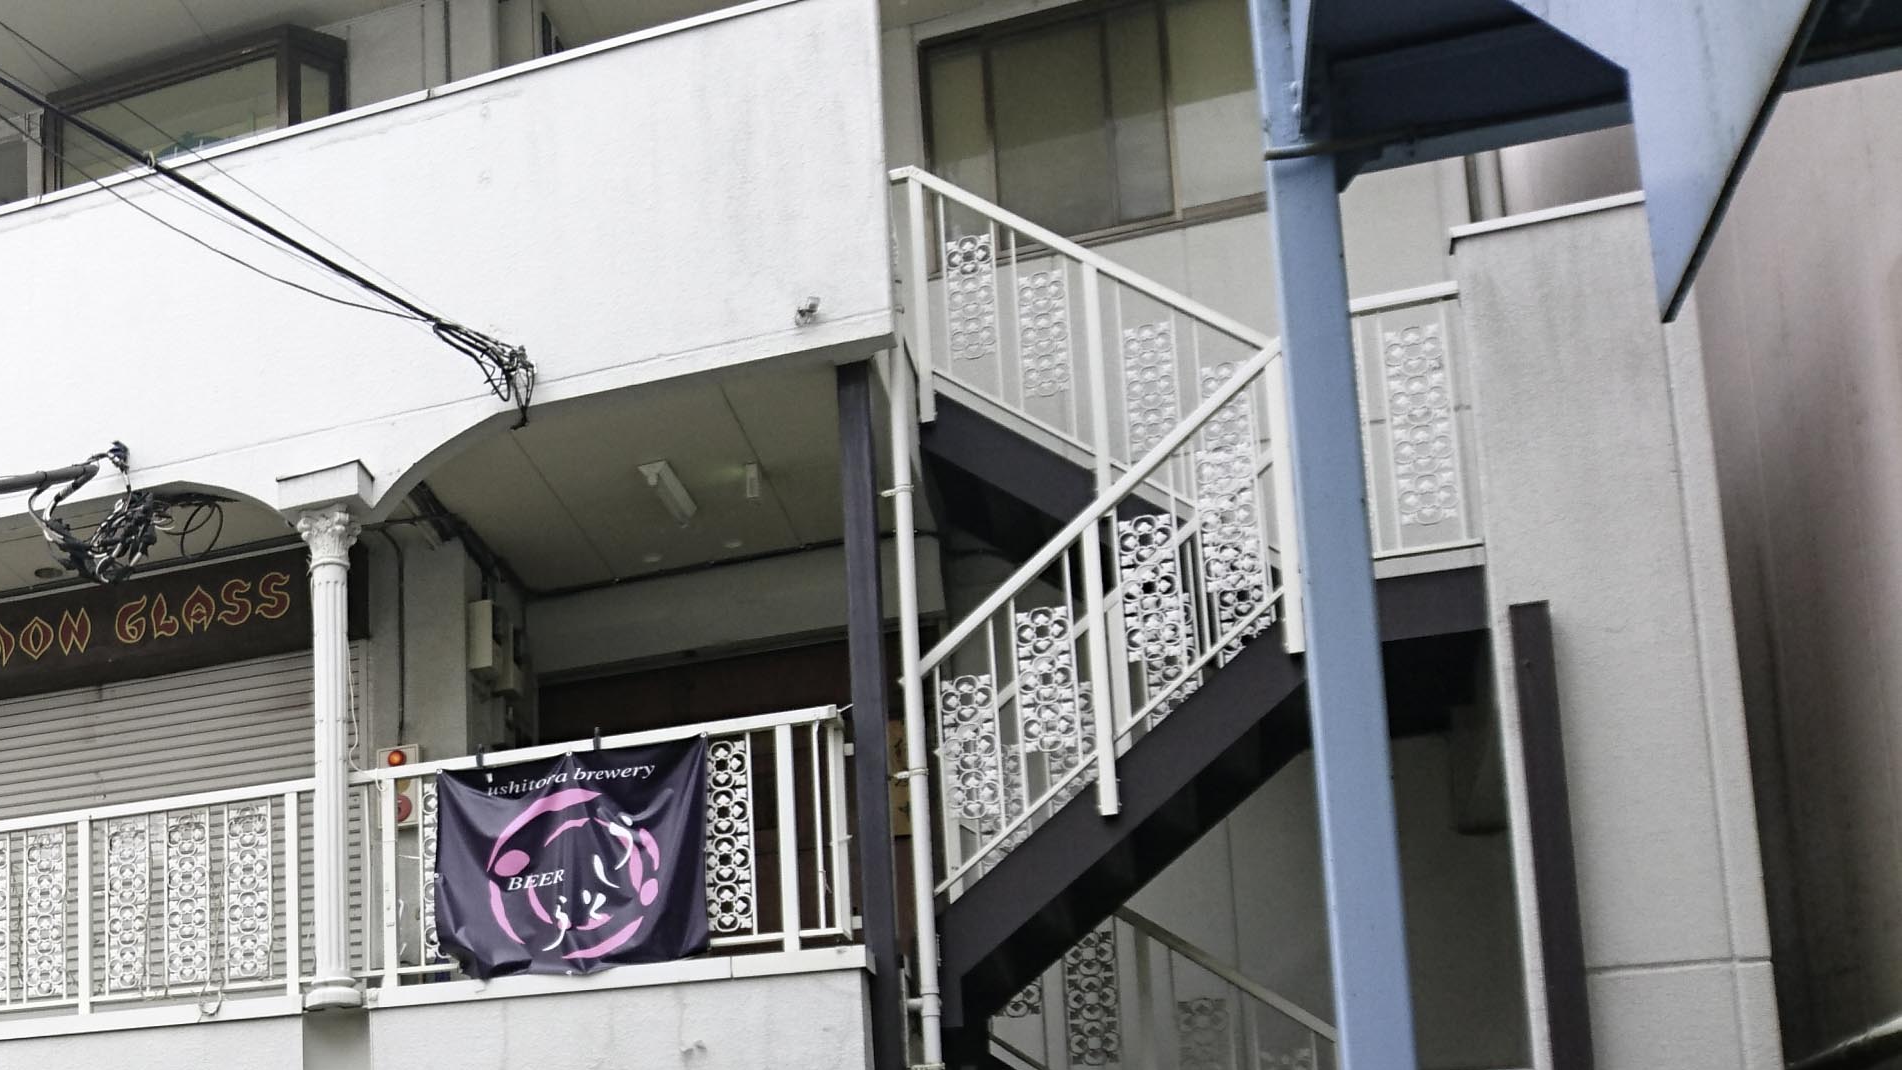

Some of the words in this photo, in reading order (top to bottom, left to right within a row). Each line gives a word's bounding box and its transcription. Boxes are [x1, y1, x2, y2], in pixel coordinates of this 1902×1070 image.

[116, 572, 290, 643] GLASS
[487, 772, 567, 797] ushitora
[574, 764, 655, 781] brewery
[507, 869, 565, 891] BEER
